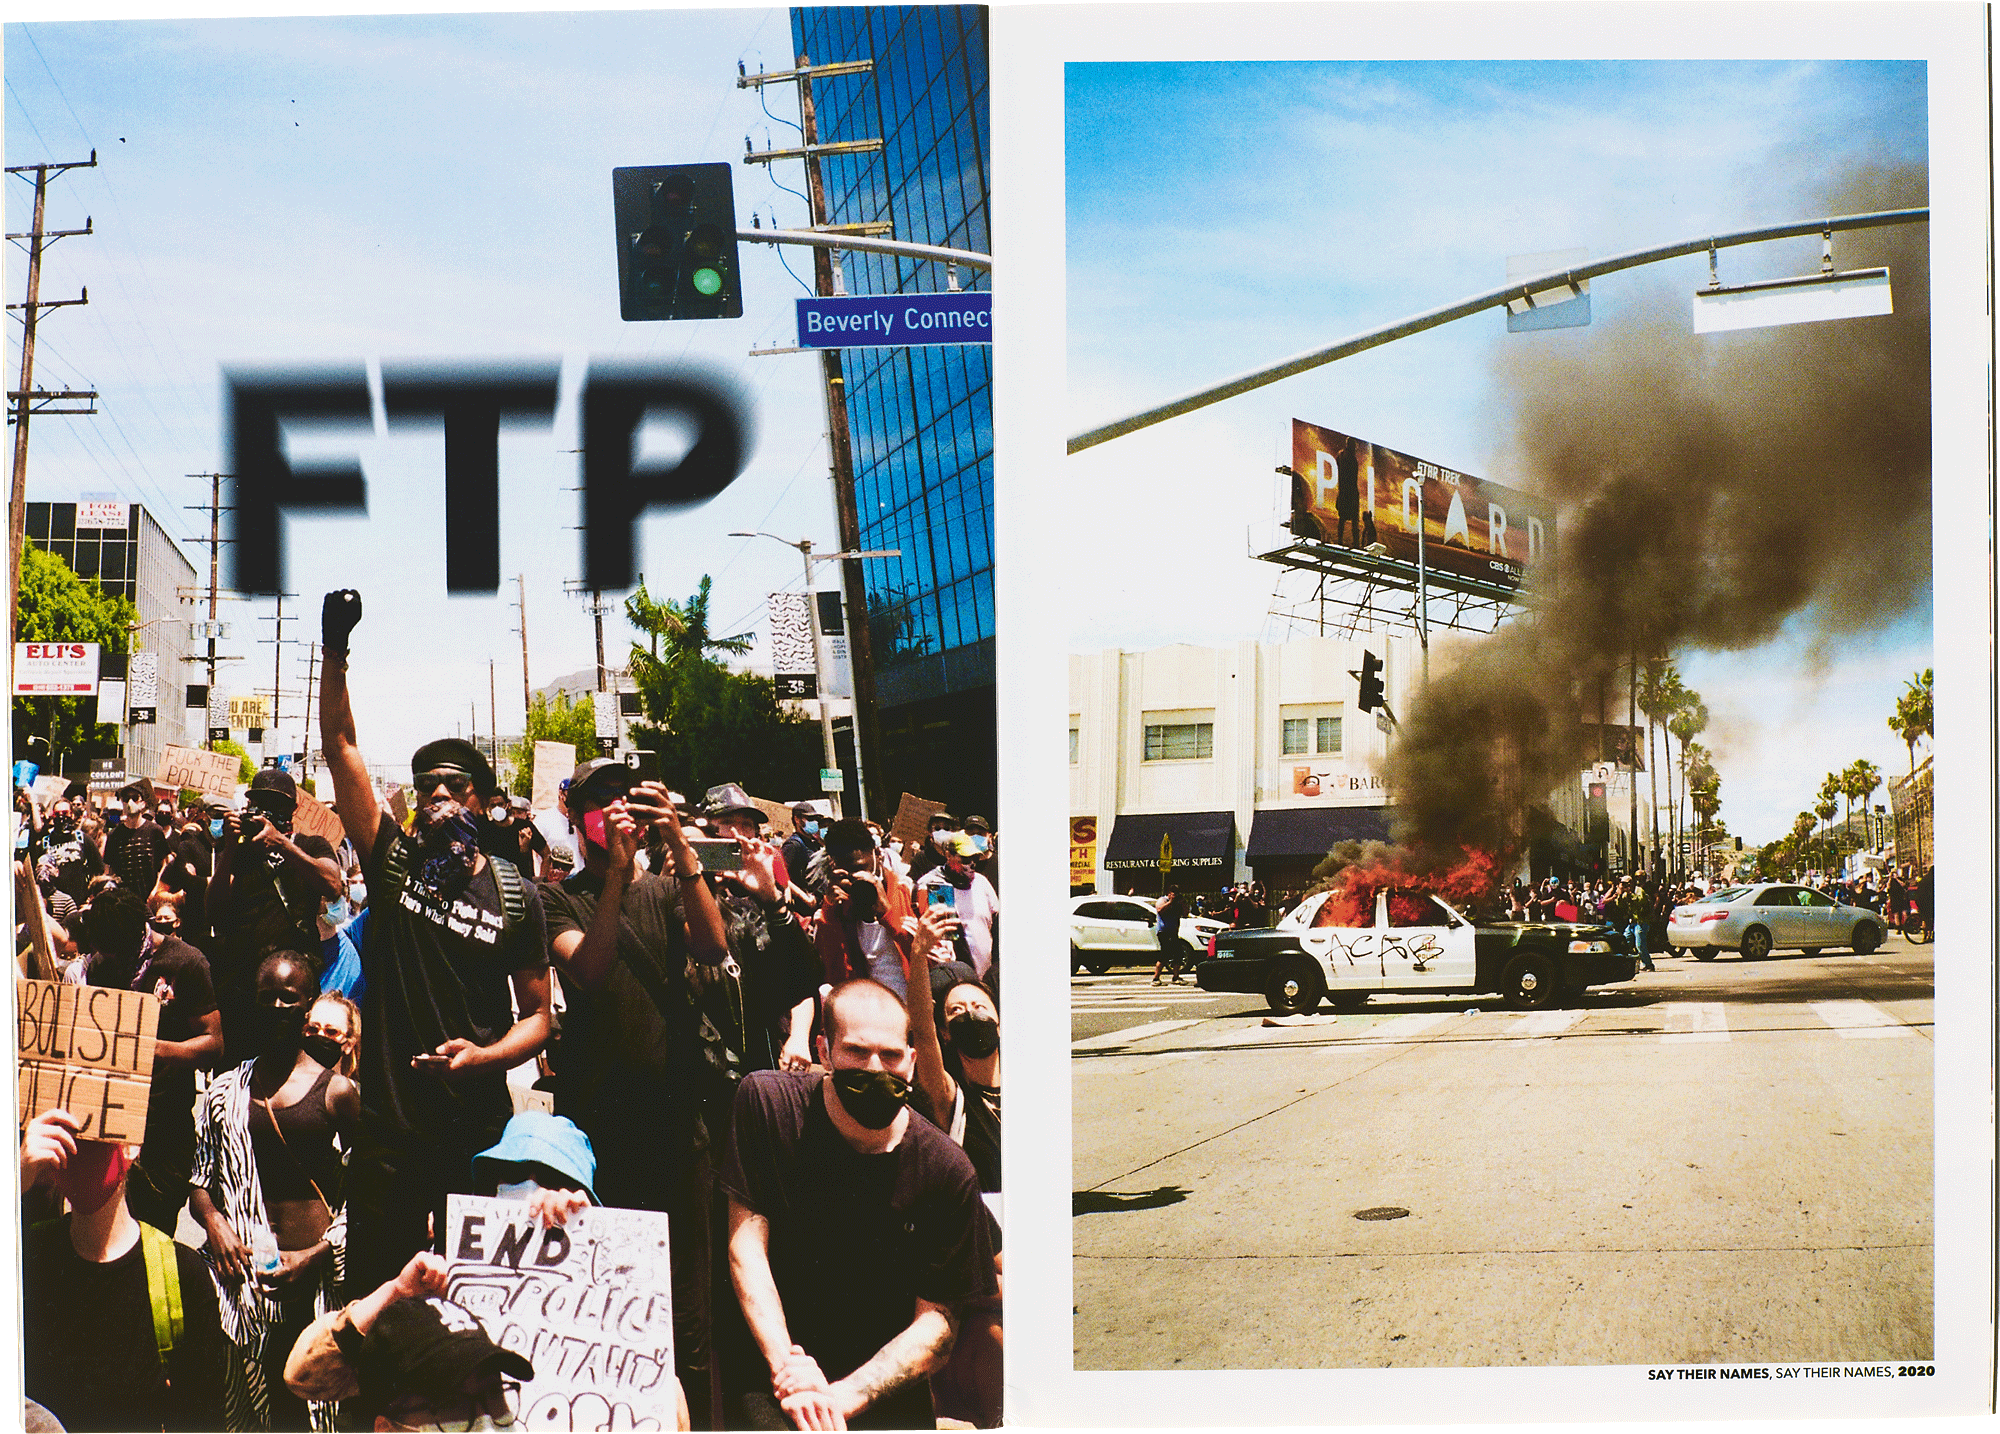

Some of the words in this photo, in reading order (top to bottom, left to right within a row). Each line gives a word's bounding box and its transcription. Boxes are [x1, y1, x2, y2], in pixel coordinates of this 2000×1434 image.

[806, 309, 894, 336] Beverly
[904, 306, 993, 330] Connec
[1417, 461, 1439, 480] STAR
[1440, 468, 1461, 487] TREK
[88, 502, 118, 510] FOR
[1316, 449, 1544, 560] PICARD
[1489, 560, 1504, 572] CBS
[26, 644, 87, 659] ELI'S
[241, 701, 263, 714] ARE
[102, 761, 113, 770] HE
[166, 747, 204, 767] FUCK
[210, 754, 233, 771] THE
[90, 781, 125, 790] BREATHE
[166, 765, 231, 794] POLICE
[295, 796, 341, 841] EFUND
[1106, 858, 1150, 869] RESTAURANT
[1150, 859, 1155, 868] &
[1156, 858, 1189, 868] CERING
[1192, 857, 1222, 867] SUPPLIES
[451, 900, 478, 920] Fight
[425, 905, 445, 925] What
[474, 925, 497, 944] Said
[1324, 932, 1444, 978] ACAB
[16, 981, 144, 1071] BOLISH
[18, 1060, 131, 1139] OLICE
[457, 1216, 571, 1269] END
[509, 1276, 670, 1342] POLICE
[501, 1324, 668, 1394] RUTALITY
[1648, 1369, 1673, 1380] SAY
[1677, 1369, 1716, 1380] THEIR
[1720, 1368, 1773, 1380] NAMES,
[1776, 1368, 1800, 1379] SAY
[1804, 1367, 1840, 1378] THEIR
[1844, 1366, 1895, 1379] NAMES,
[1898, 1365, 1936, 1377] 2020
